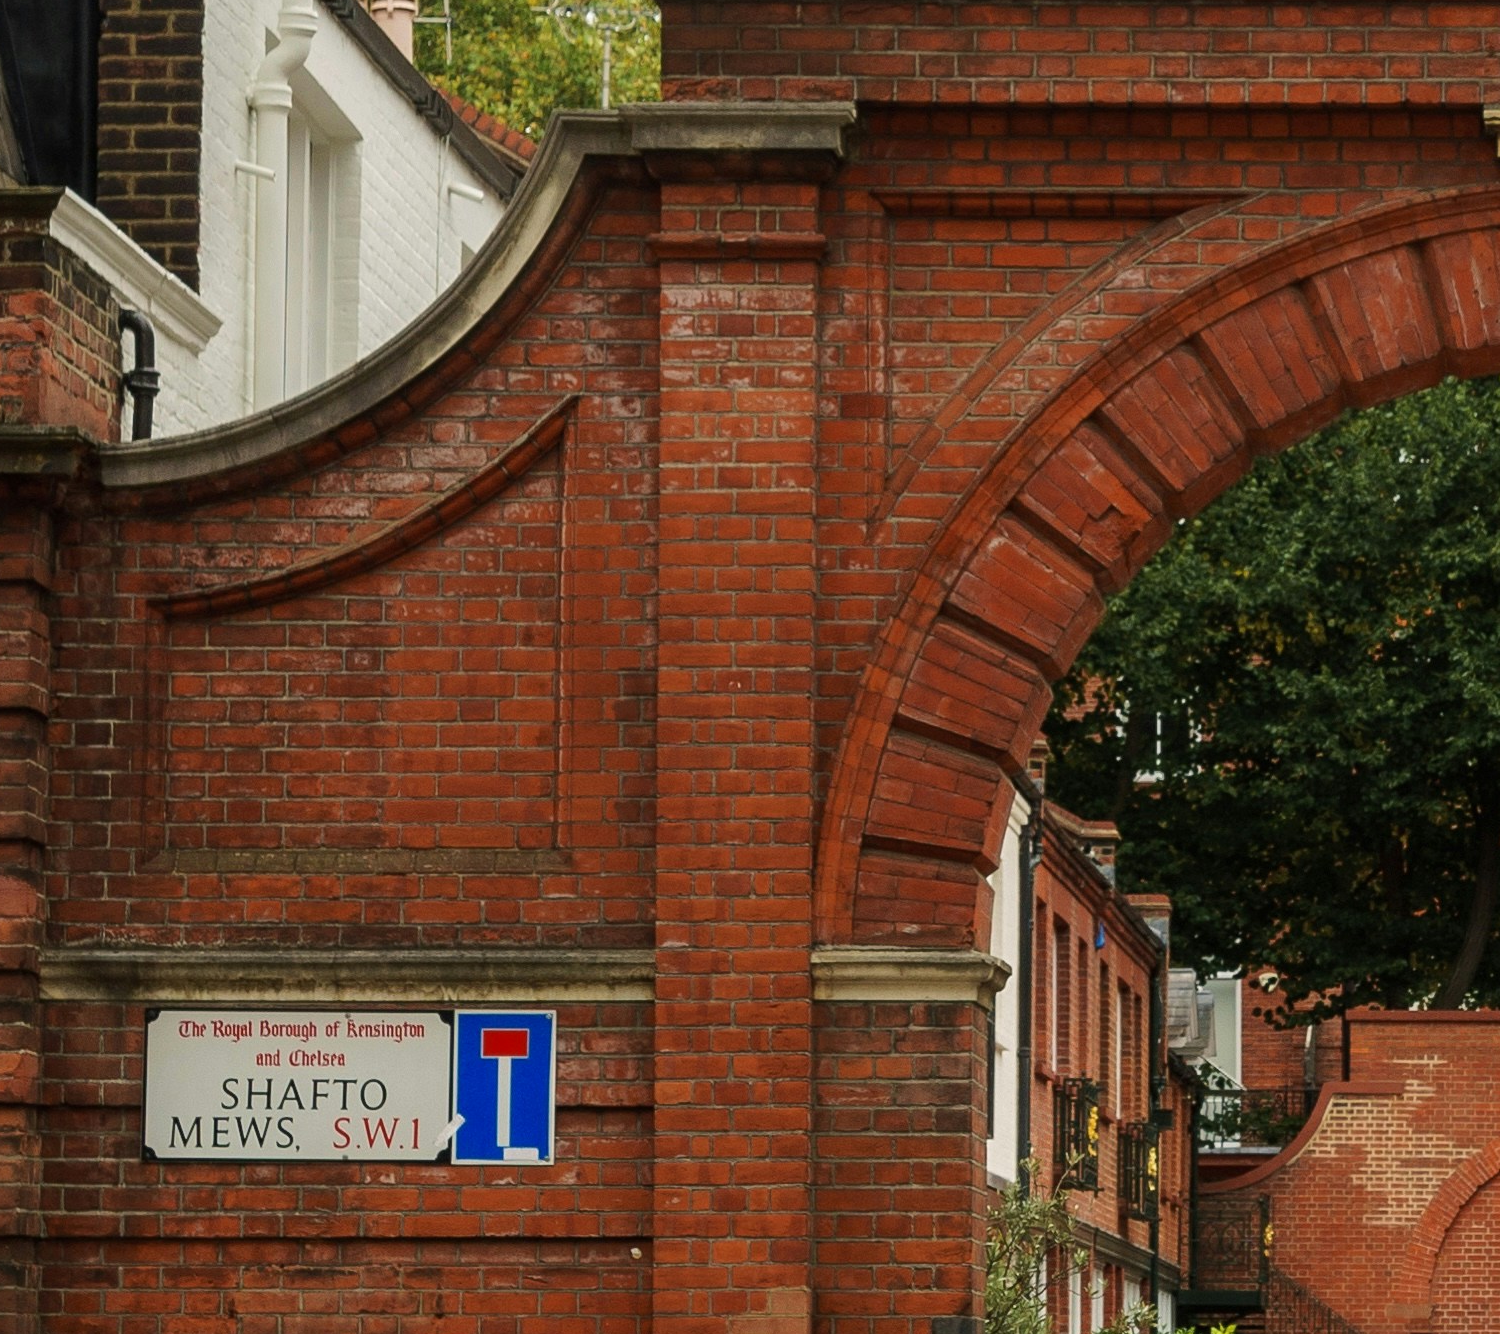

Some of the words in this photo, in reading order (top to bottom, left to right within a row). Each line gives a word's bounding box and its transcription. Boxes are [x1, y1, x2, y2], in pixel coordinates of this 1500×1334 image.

[178, 1020, 207, 1038] The
[210, 1020, 253, 1044] Royal
[259, 1020, 317, 1043] Borough
[325, 1020, 342, 1038] of
[346, 1019, 425, 1044] Kensington
[256, 1049, 281, 1067] and
[288, 1049, 346, 1067] Chelsea
[220, 1077, 388, 1111] SHAFTO
[168, 1116, 301, 1153] MEWS,
[332, 1117, 420, 1150] S.W.1
